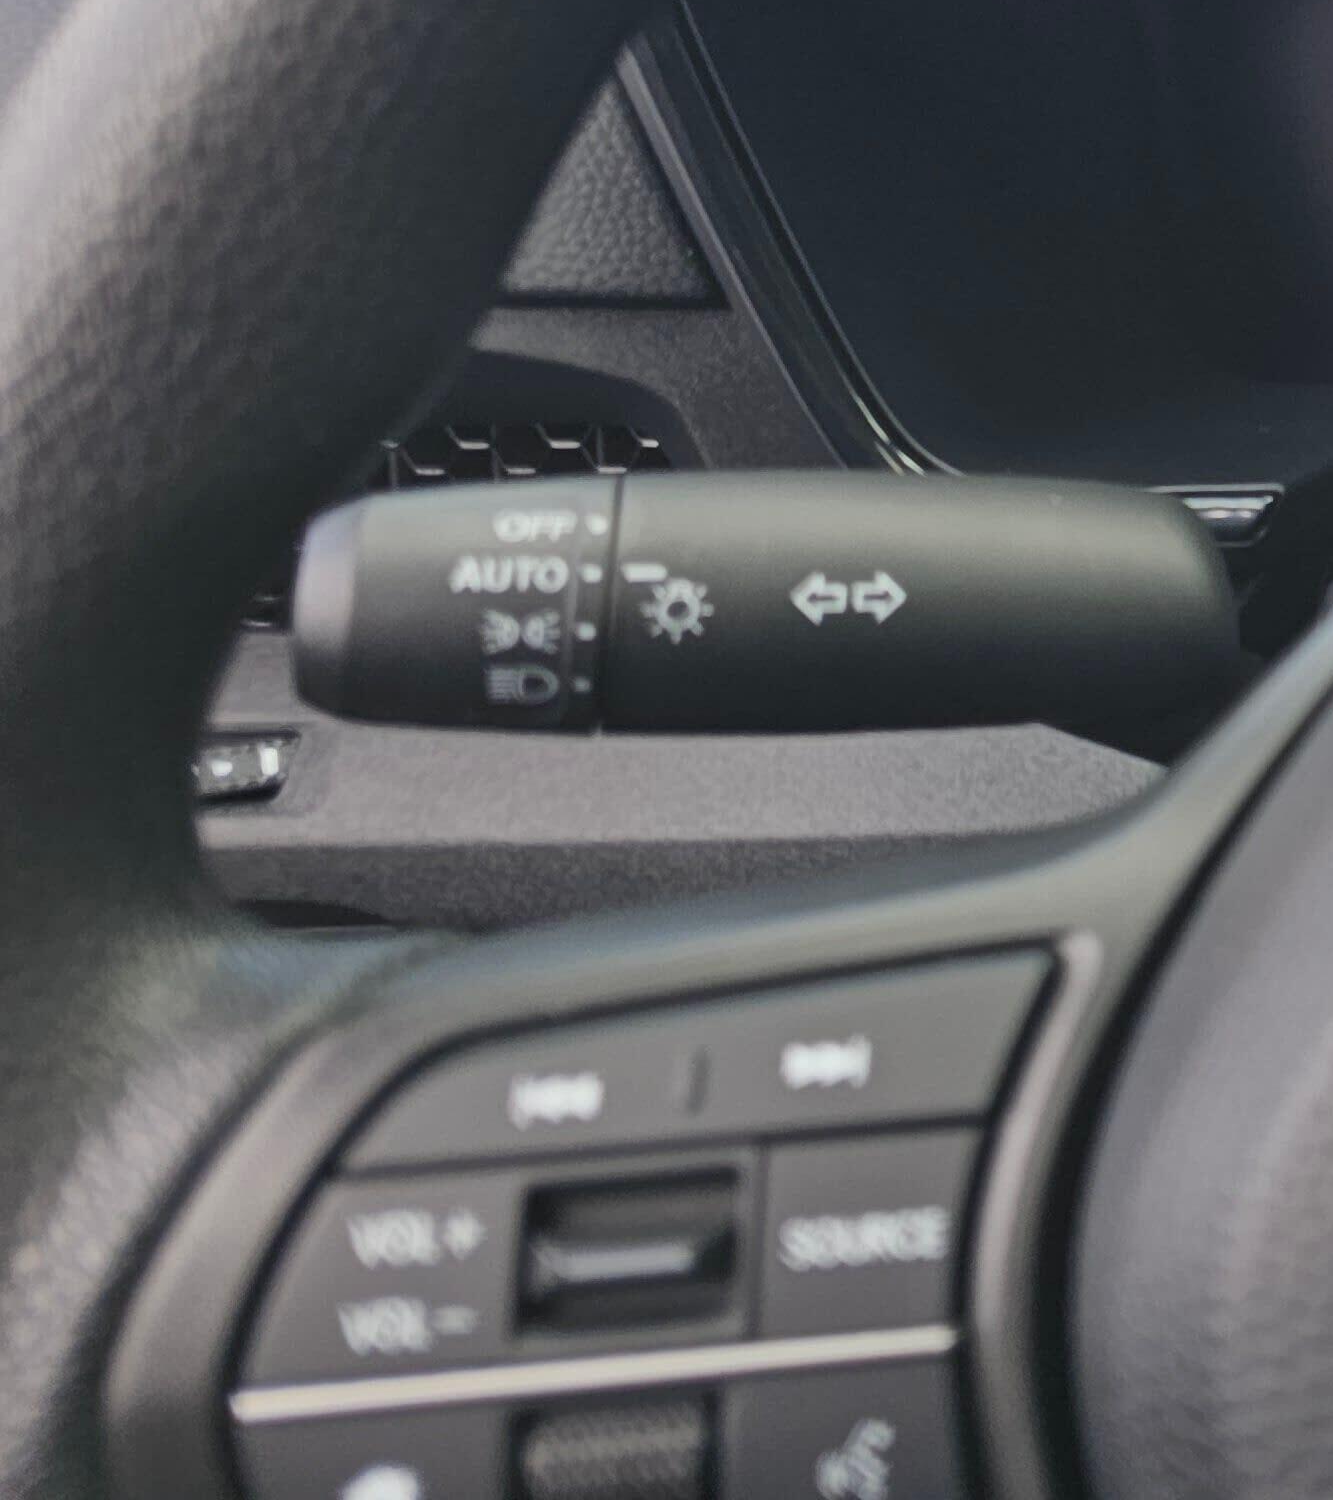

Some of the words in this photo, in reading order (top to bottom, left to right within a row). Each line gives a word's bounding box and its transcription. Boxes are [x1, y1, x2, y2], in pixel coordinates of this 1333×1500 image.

[494, 510, 577, 542] OFF
[450, 556, 569, 594] AUTO
[779, 1206, 951, 1270] SOURCE
